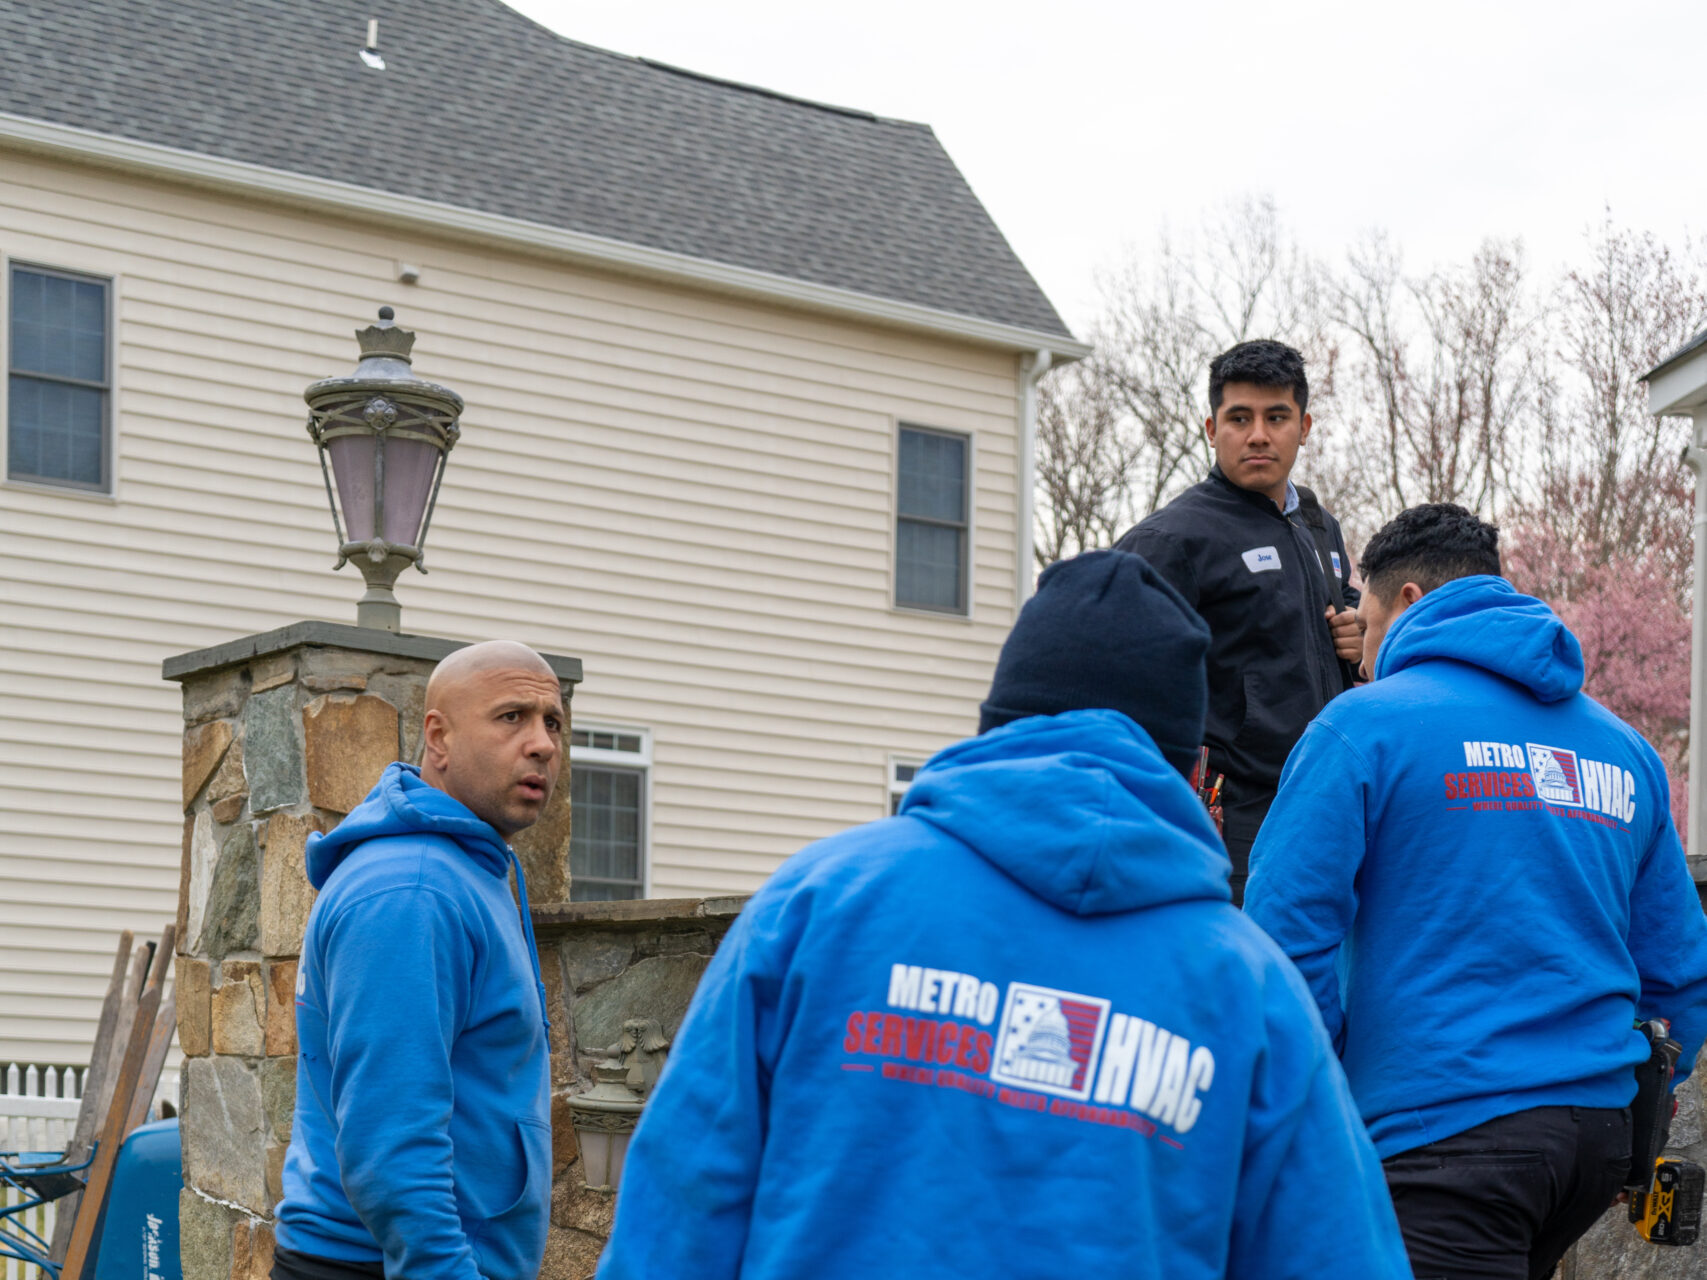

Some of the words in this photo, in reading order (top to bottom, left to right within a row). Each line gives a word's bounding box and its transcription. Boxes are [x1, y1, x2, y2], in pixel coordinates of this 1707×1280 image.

[1463, 741, 1526, 769] METRO
[1444, 771, 1536, 800] SERVICES
[1472, 801, 1503, 812] WHERE
[1505, 801, 1543, 812] QUALITY
[1580, 758, 1635, 824] HVAC
[887, 963, 999, 1026] METRO
[843, 1010, 994, 1075] SERVICES
[1093, 1012, 1216, 1134] HVAC
[1658, 1188, 1675, 1223] XR
